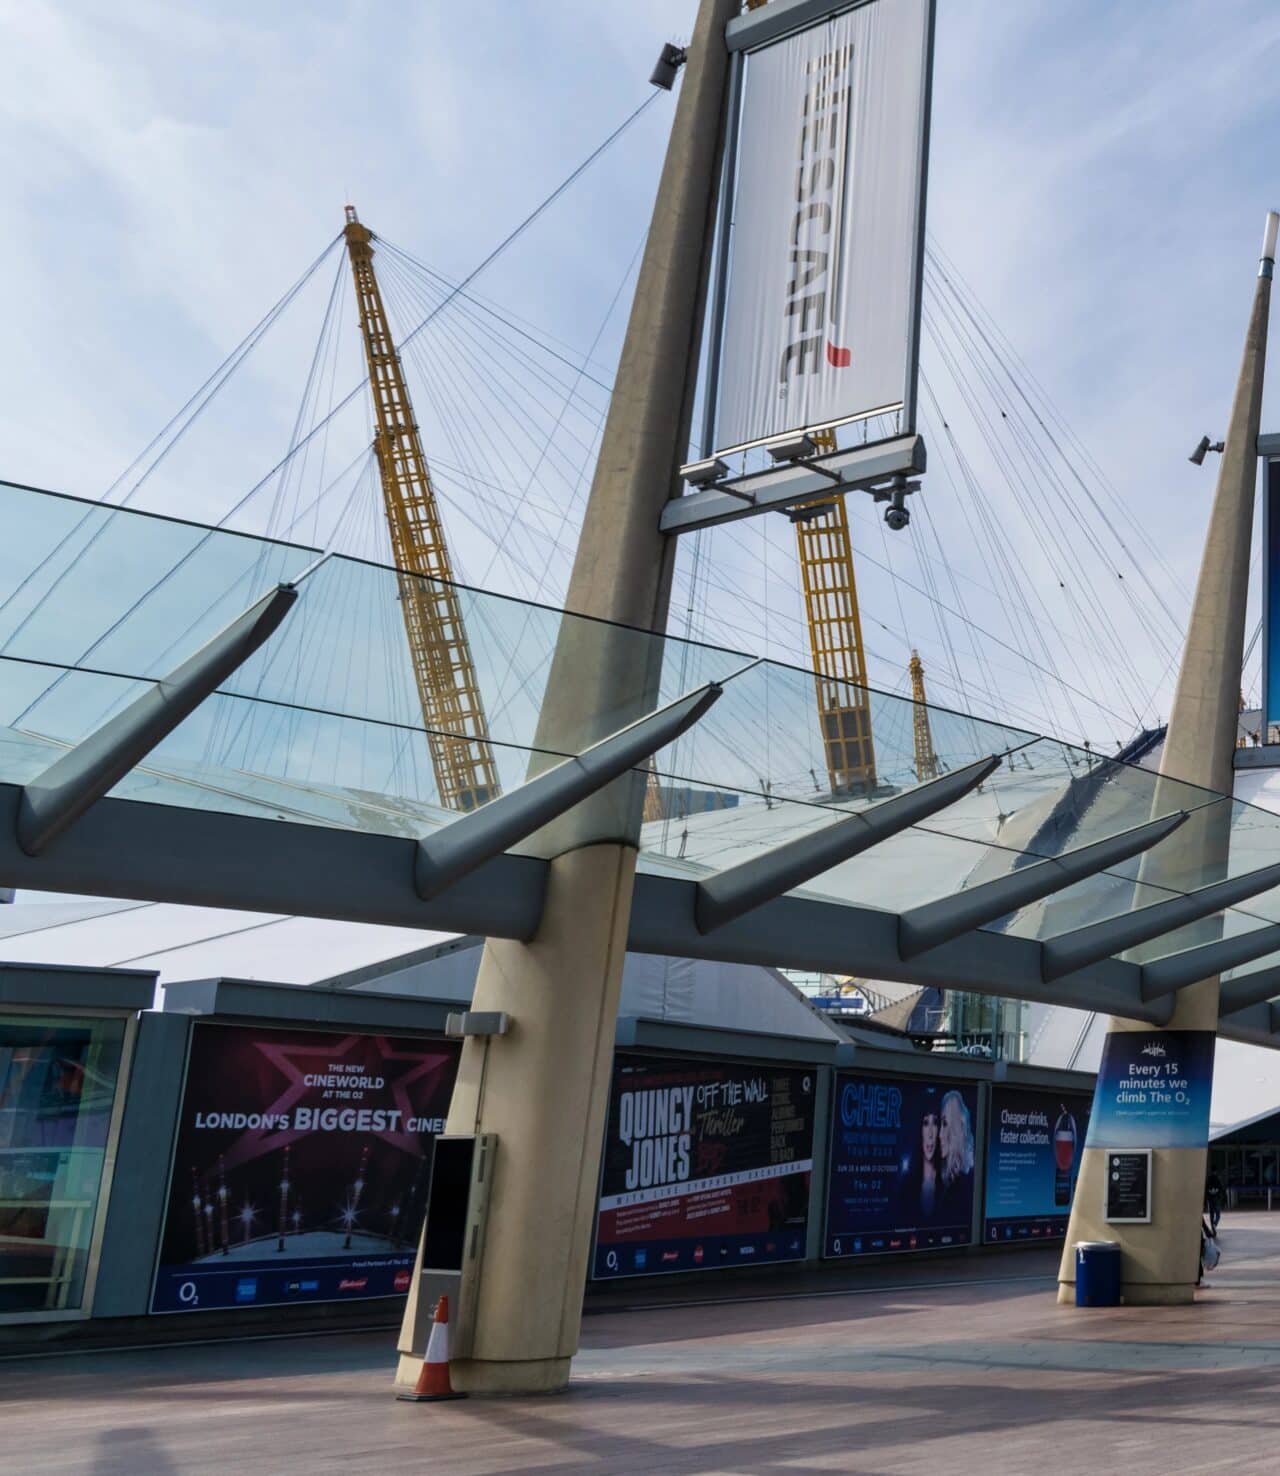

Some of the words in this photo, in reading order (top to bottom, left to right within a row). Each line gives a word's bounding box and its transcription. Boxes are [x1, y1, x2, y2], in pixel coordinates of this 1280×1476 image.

[328, 1064, 344, 1073] THE
[345, 1064, 365, 1073] NEW
[1129, 1063, 1160, 1077] Every
[1164, 1063, 1178, 1074] 15
[303, 1074, 384, 1089] CINEWORLD
[1119, 1078, 1165, 1089] minutes
[1169, 1079, 1188, 1089] we
[322, 1090, 335, 1099] AT
[335, 1090, 351, 1100] THE
[696, 1081, 720, 1109] OFF
[720, 1079, 743, 1107] THE
[743, 1077, 769, 1103] WALL
[1116, 1091, 1147, 1103] climb
[1150, 1091, 1171, 1103] The
[1175, 1091, 1190, 1105] O2
[841, 1082, 903, 1129] CHER
[195, 1112, 290, 1130] LONDON'S
[294, 1107, 402, 1133] BIGGEST
[619, 1085, 695, 1147] QUINCY
[1001, 1109, 1027, 1128] Cheaper
[1000, 1128, 1018, 1145] faster
[625, 1134, 691, 1190] JONES
[179, 1281, 199, 1305] O2
